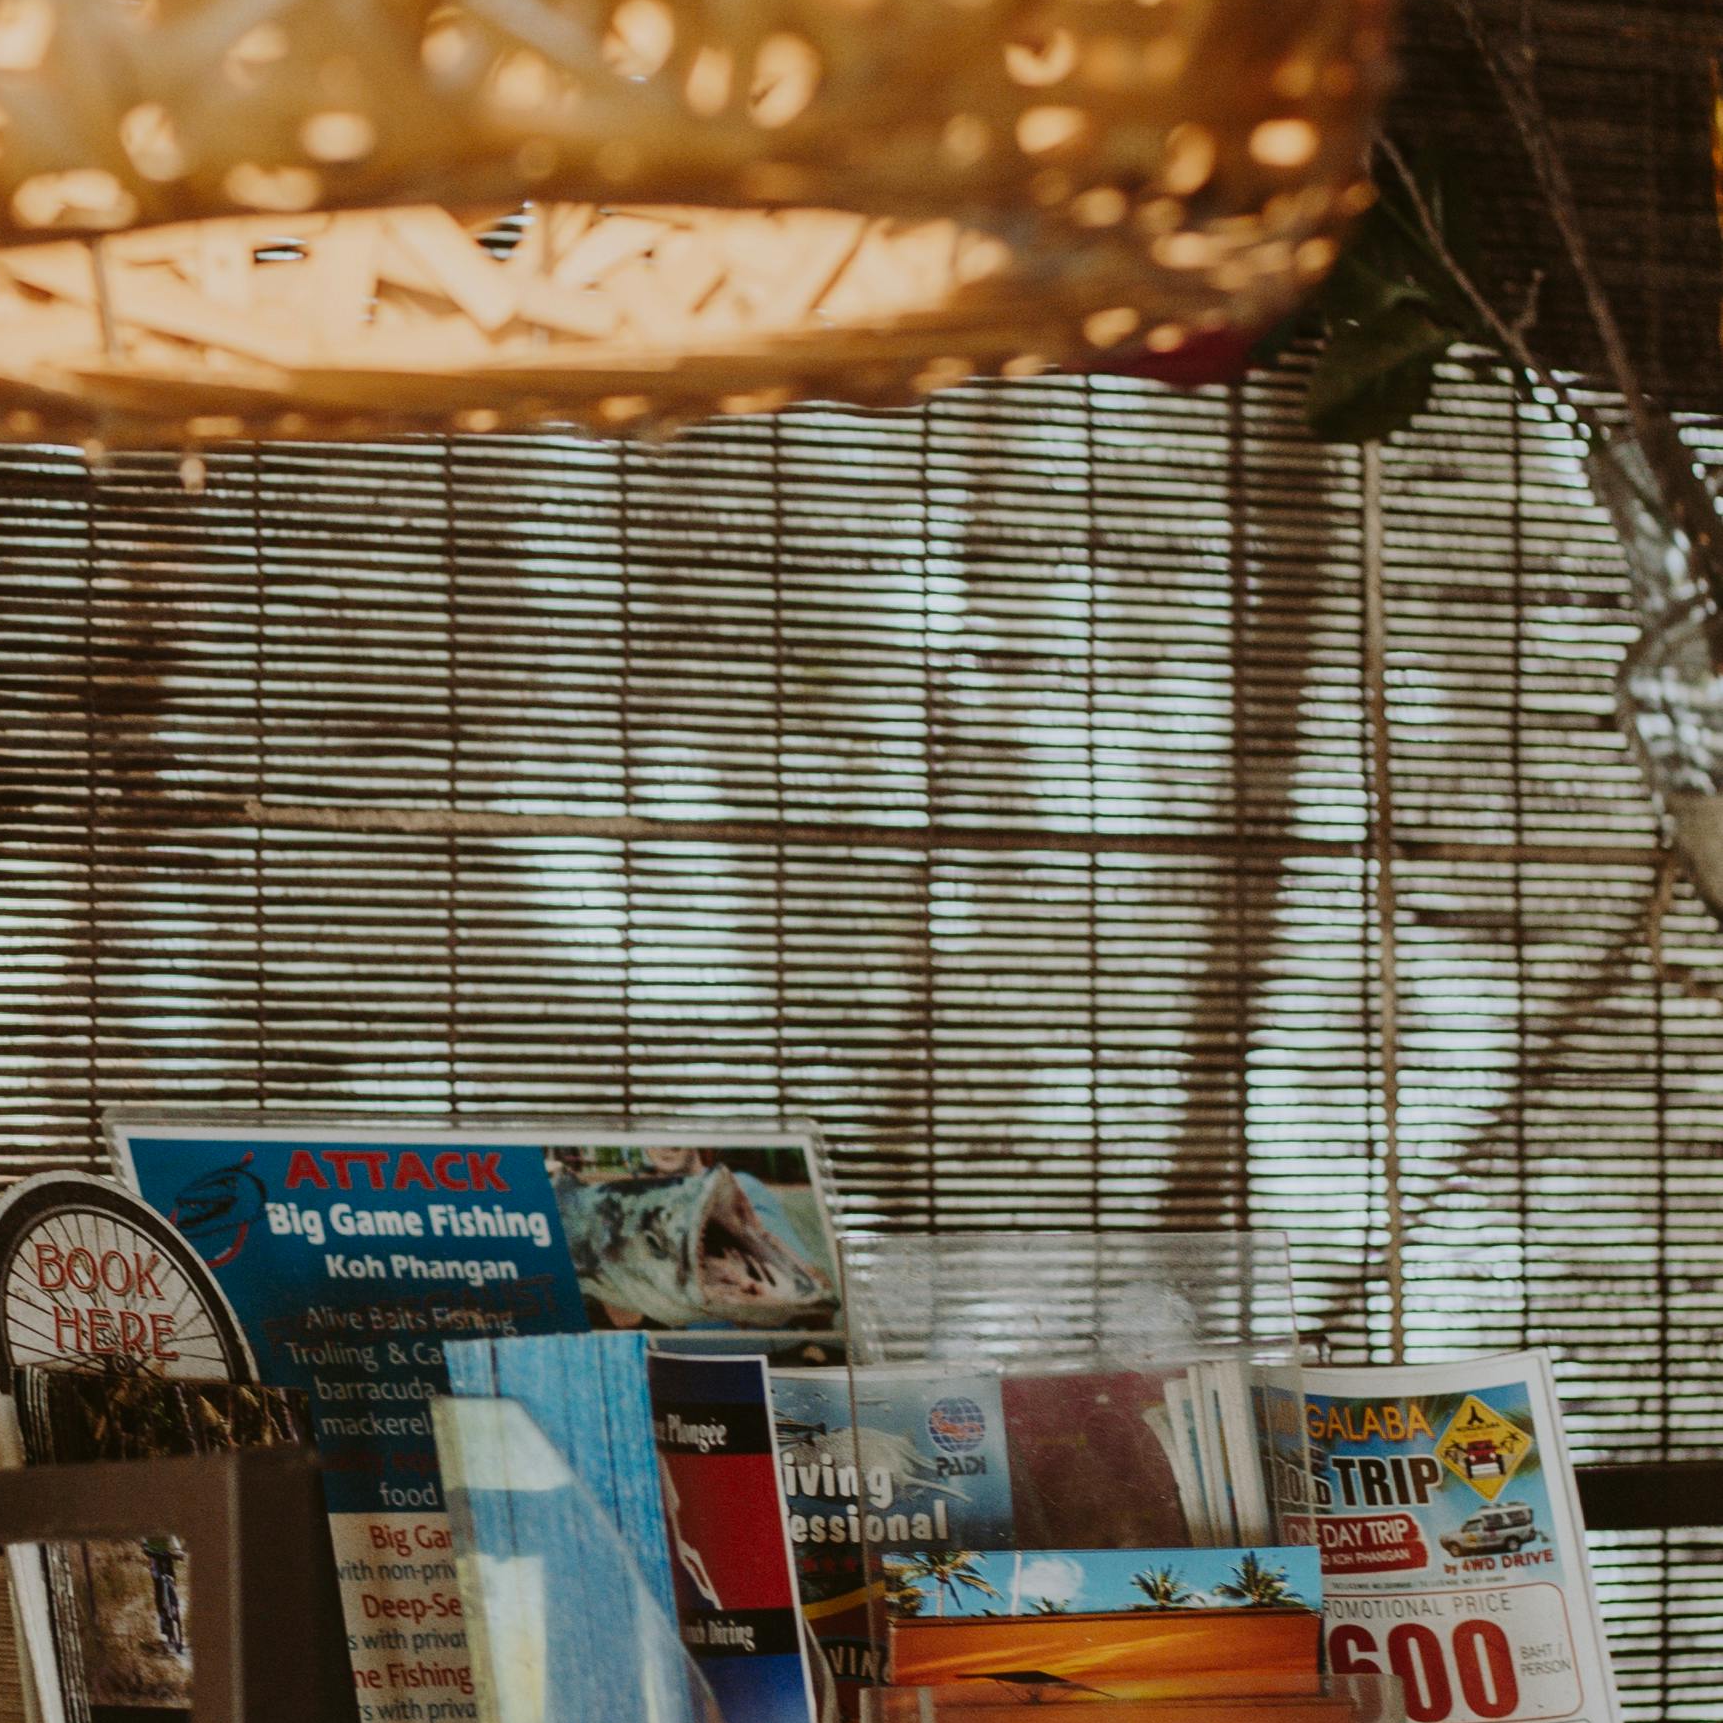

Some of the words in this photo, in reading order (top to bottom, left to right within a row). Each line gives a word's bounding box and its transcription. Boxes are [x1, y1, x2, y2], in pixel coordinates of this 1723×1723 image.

[284, 1150, 510, 1191] ATTACK
[265, 1203, 325, 1245] Big
[329, 1203, 423, 1236] Game
[428, 1205, 552, 1247] Fishing
[36, 1244, 165, 1300] BOOK
[325, 1254, 385, 1278] Koh
[391, 1255, 518, 1287] Phangan
[52, 1306, 180, 1361] HERE
[306, 1306, 364, 1329] Alive
[373, 1307, 426, 1329] Baits
[433, 1308, 517, 1337] Fishing
[389, 1344, 409, 1364] &
[316, 1379, 436, 1400] barracuda
[321, 1412, 430, 1436] mackerel
[380, 1483, 439, 1506] food
[1332, 1457, 1440, 1506] TRIP
[370, 1525, 412, 1557] Big
[1322, 1523, 1366, 1548] DAY
[1365, 1518, 1409, 1544] TRIP
[1462, 1558, 1495, 1572] 4WD
[1502, 1548, 1554, 1568] DRIVE
[1454, 1593, 1512, 1613] PRICE
[362, 1629, 407, 1649] with
[1520, 1644, 1553, 1659] BAHT
[386, 1662, 474, 1695] Fishing
[1520, 1661, 1571, 1676] PERSON
[378, 1699, 424, 1720] with
